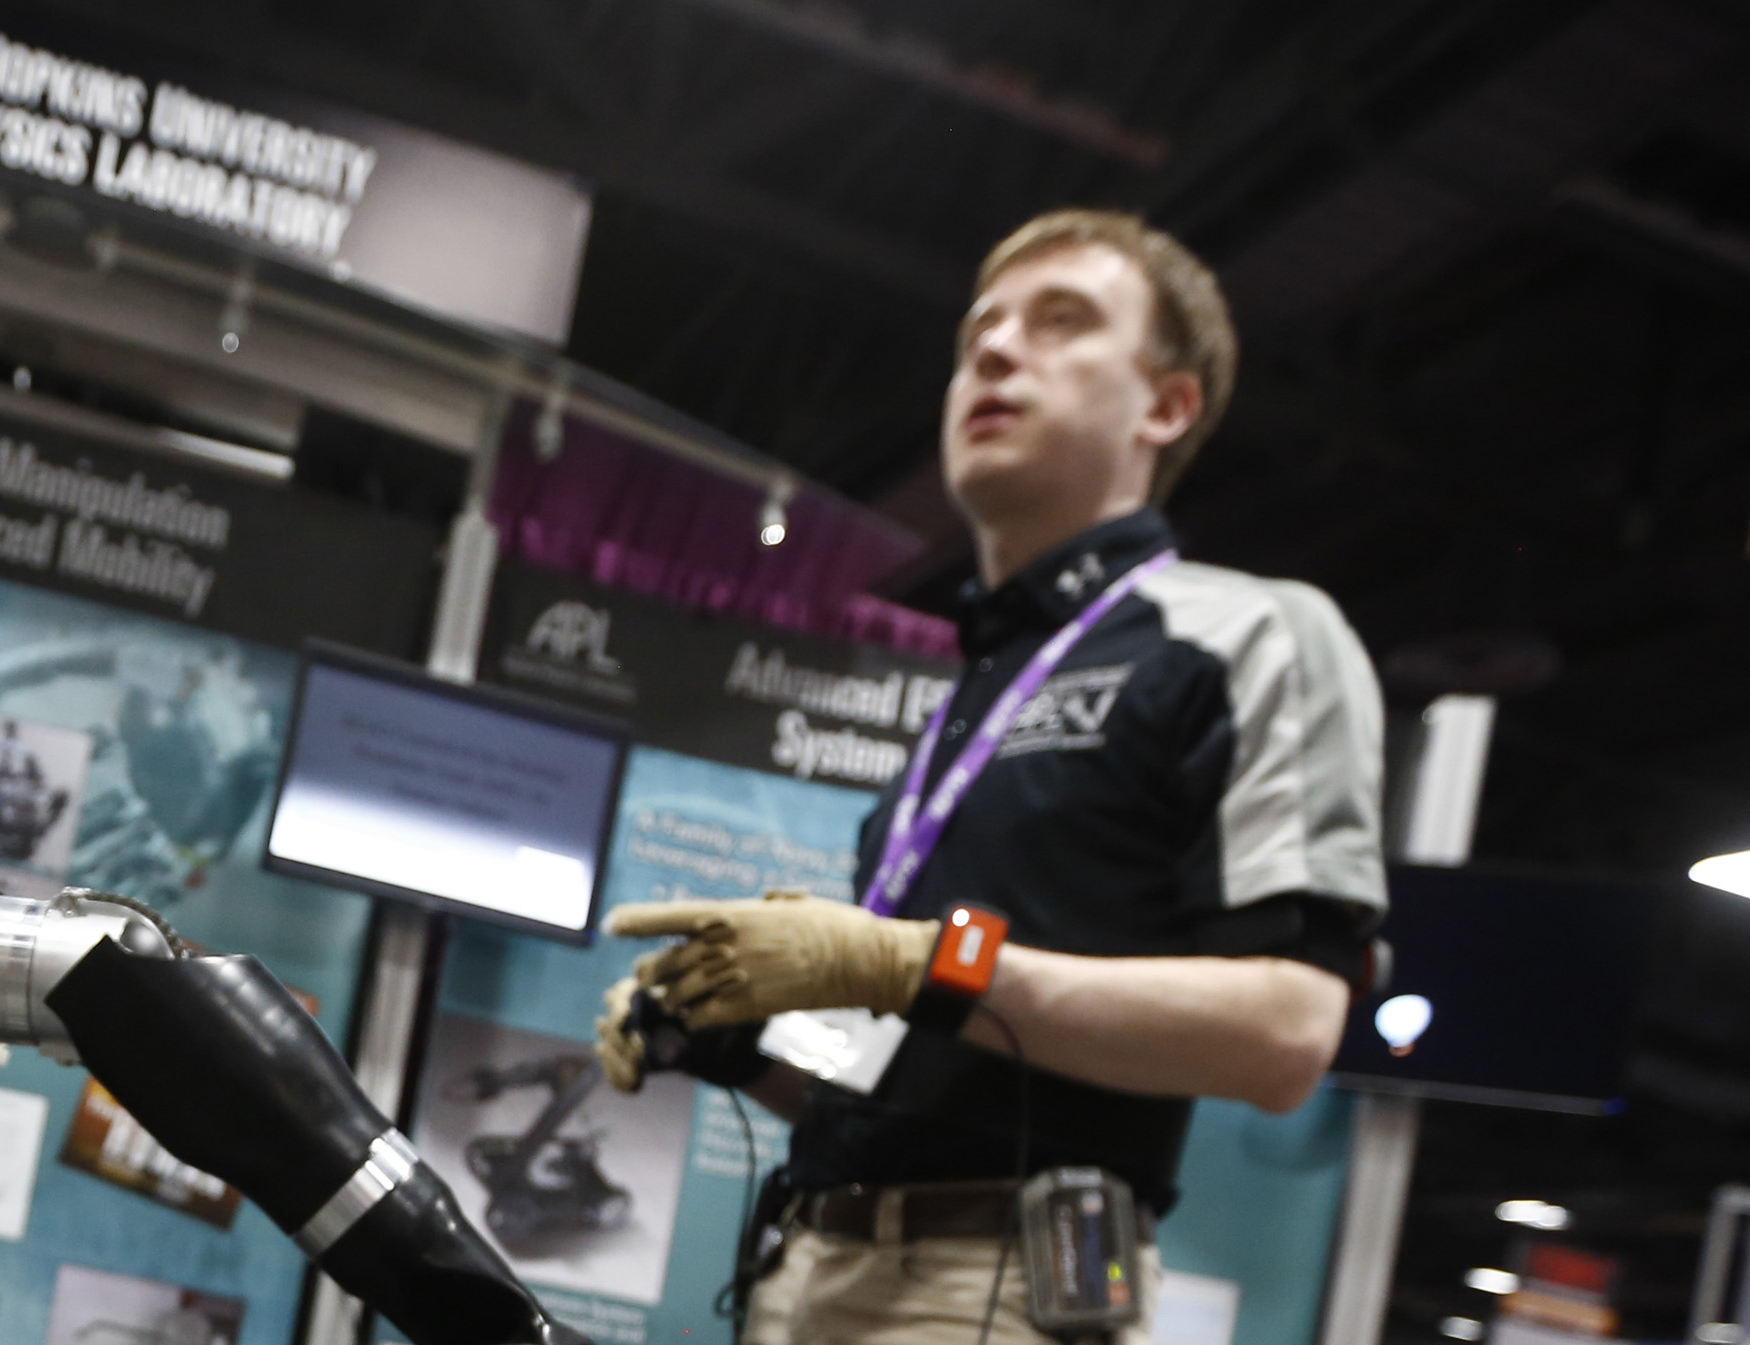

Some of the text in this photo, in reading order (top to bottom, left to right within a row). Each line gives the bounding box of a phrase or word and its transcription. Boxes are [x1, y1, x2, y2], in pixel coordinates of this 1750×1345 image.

[93, 131, 351, 257] LABORATORY
[149, 80, 379, 204] UNIVERSITY
[57, 518, 215, 617] Mobility
[725, 641, 905, 728] Advanced
